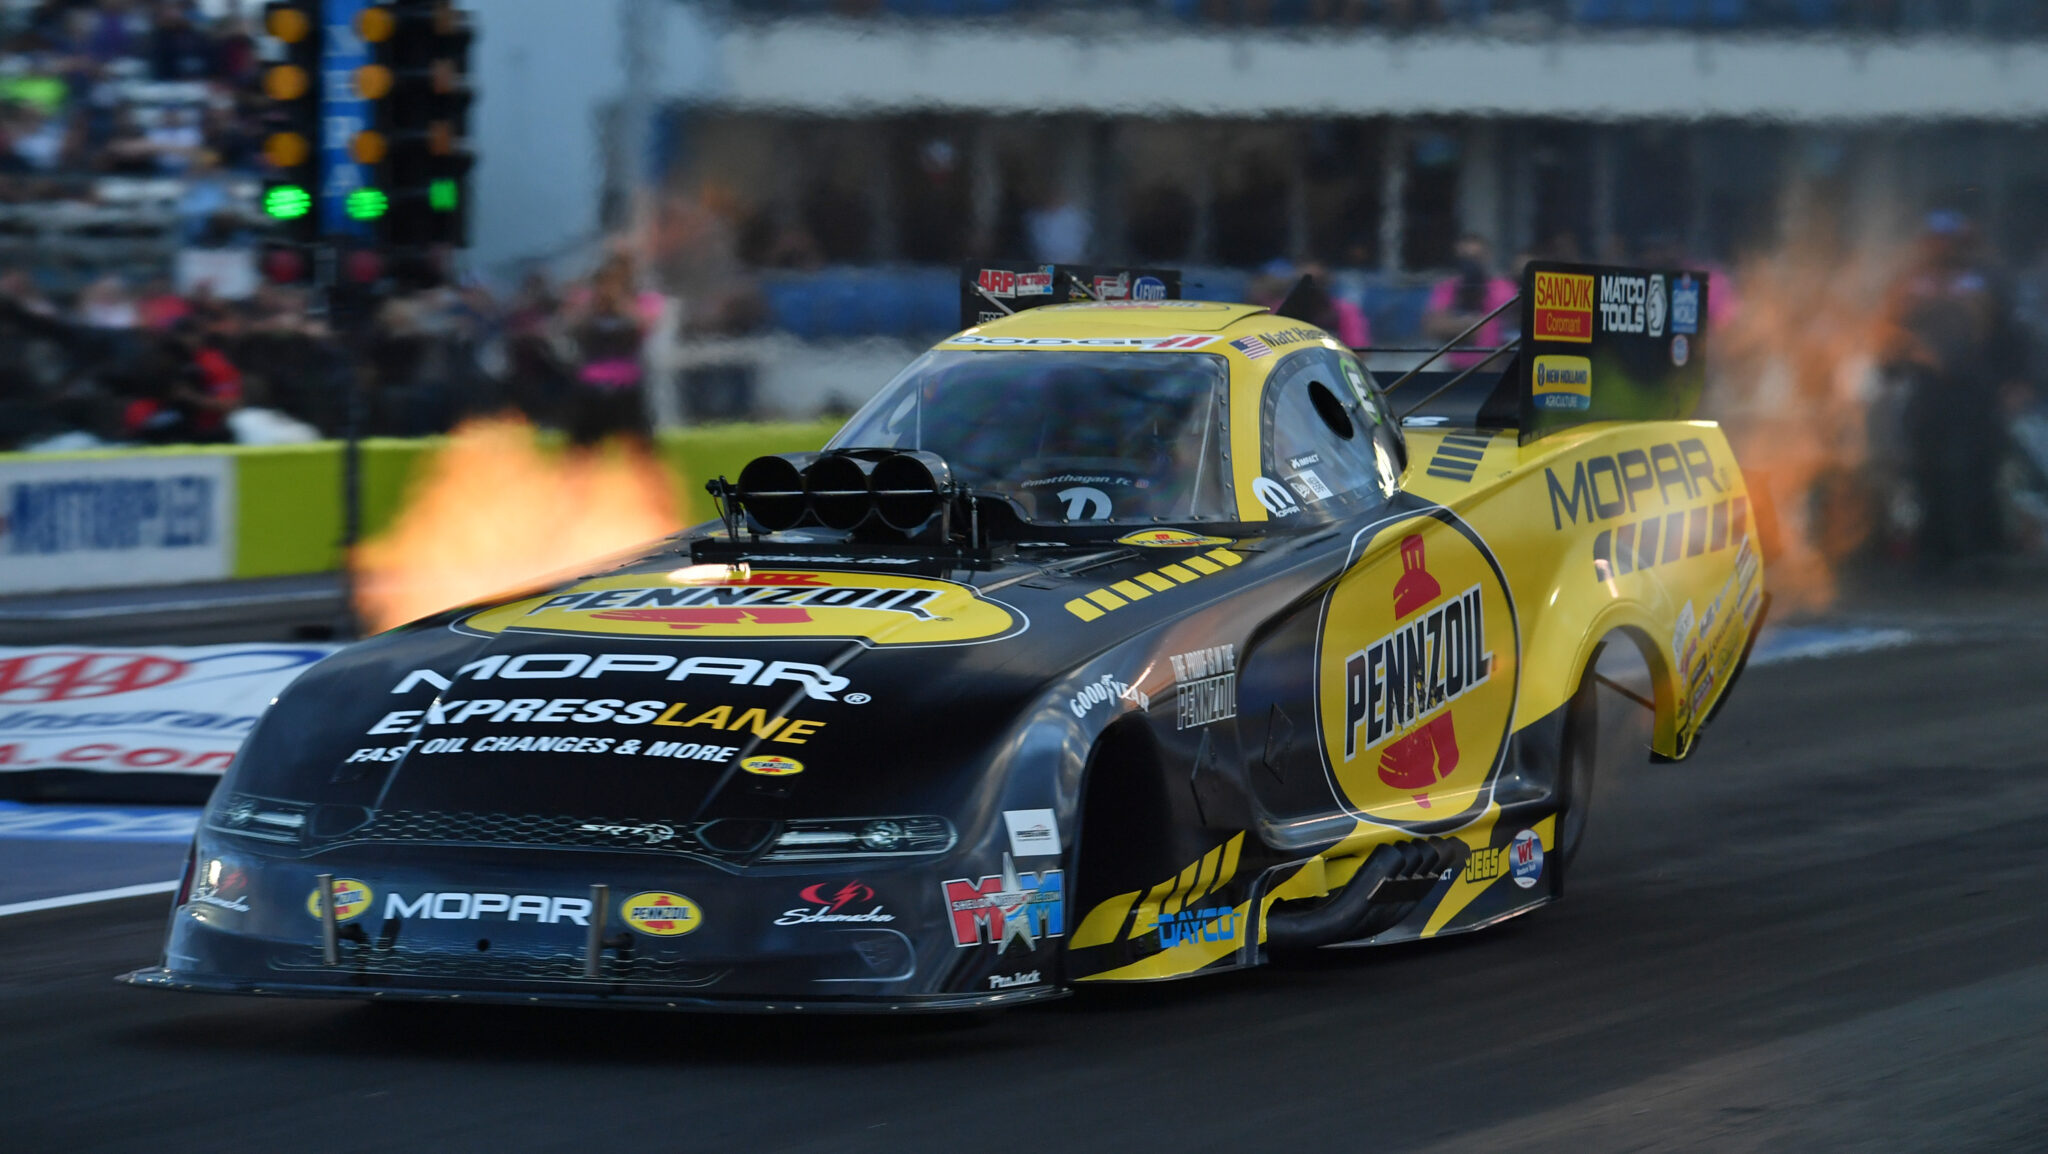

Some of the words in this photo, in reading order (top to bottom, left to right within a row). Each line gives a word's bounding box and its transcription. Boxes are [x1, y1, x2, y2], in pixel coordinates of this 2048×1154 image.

[979, 270, 1015, 293] ARP
[1537, 275, 1592, 309] SANDVIK
[1600, 275, 1646, 305] MATCO
[1547, 314, 1581, 333] Coromant
[1600, 304, 1645, 333] TOOLS
[1546, 369, 1560, 384] NEW
[1560, 369, 1588, 385] HOLLAND
[1544, 437, 1724, 530] MOPAR
[525, 585, 943, 622] PENNZOIL
[390, 653, 851, 701] MOPAR
[1343, 582, 1493, 763] PENNZOIL
[1069, 680, 1149, 719] GOODYEAR
[1176, 671, 1237, 731] PENNZOIL
[345, 739, 424, 763] FAST
[419, 737, 469, 754] OIL
[470, 736, 616, 754] CHANGES
[613, 739, 642, 756] &
[643, 740, 741, 763] MORE
[1466, 848, 1499, 884] JEGS
[384, 893, 593, 926] MOPAR
[628, 906, 693, 921] PENNZOIL
[773, 905, 896, 926] Schumacher
[1156, 905, 1237, 949] DAYCO
